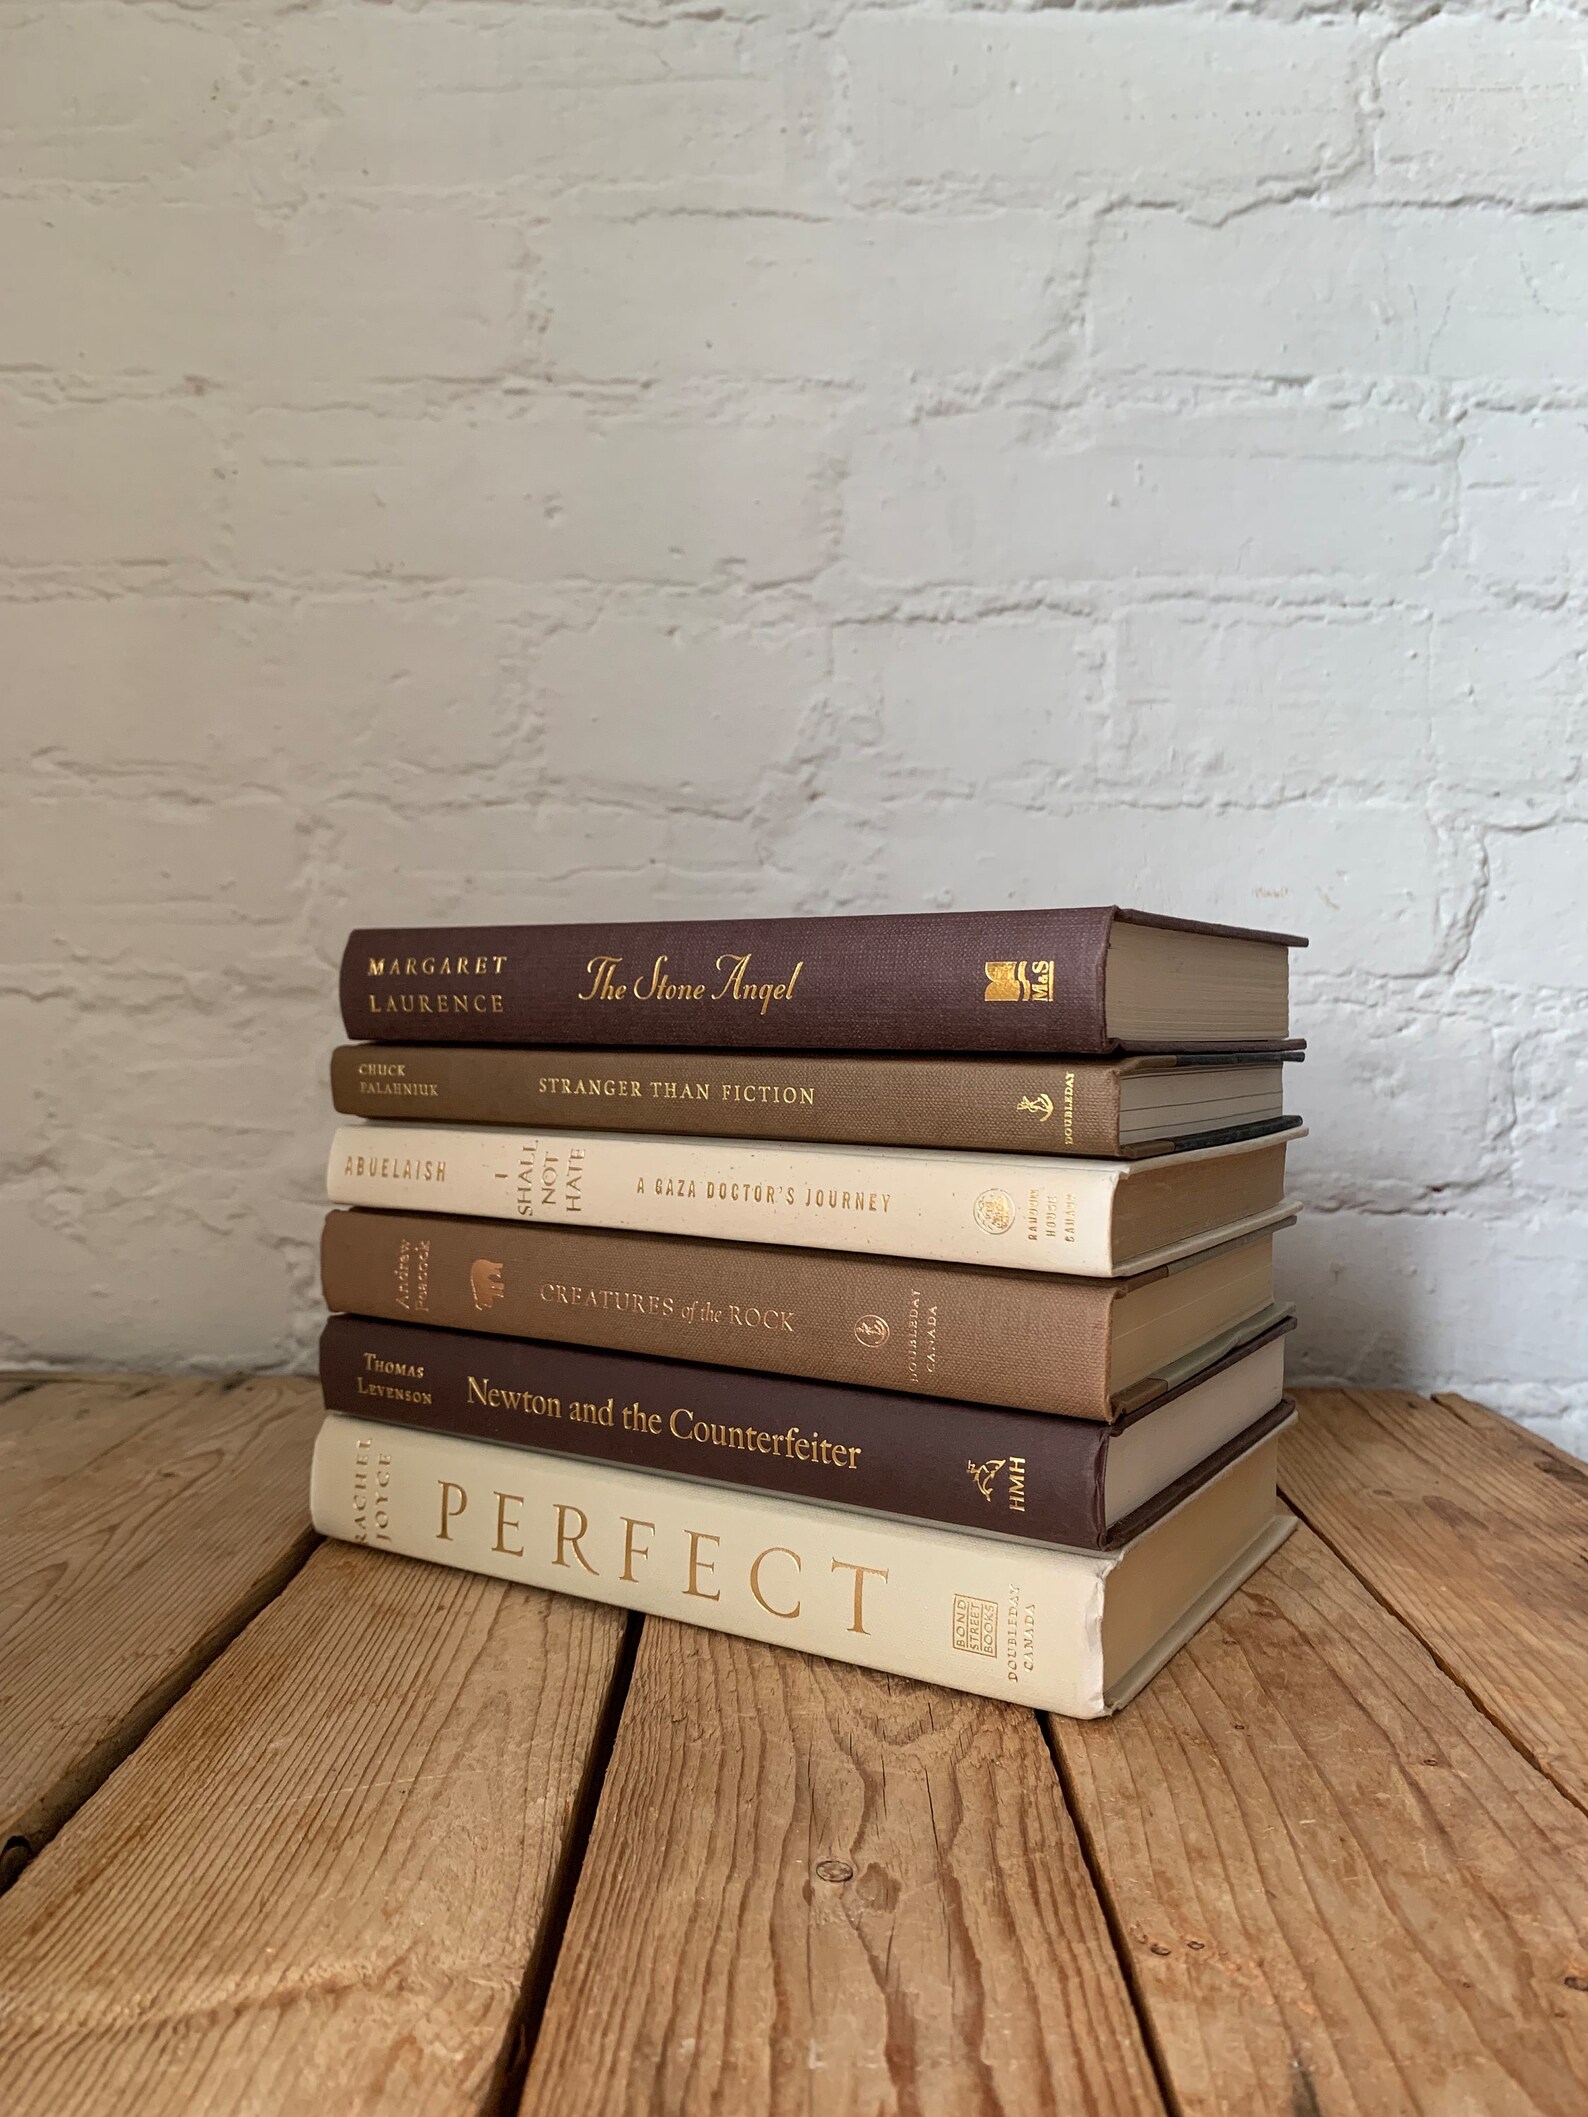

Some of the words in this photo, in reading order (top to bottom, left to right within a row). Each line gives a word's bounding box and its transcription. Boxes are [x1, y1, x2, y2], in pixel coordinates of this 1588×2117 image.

[368, 955, 507, 976] MARGARET
[578, 954, 626, 1000] The
[633, 954, 706, 1000] Stone
[711, 953, 804, 1016] Angel
[1031, 960, 1050, 1002] M&S
[369, 994, 504, 1013] LAURENCE
[358, 1063, 406, 1077] CHUCK
[360, 1081, 439, 1097] PALAHNIUK
[539, 1077, 642, 1098] STRANGER
[650, 1081, 710, 1101] THAN
[722, 1084, 815, 1105] FICTION
[1064, 1071, 1075, 1145] DOUBLEDAY
[344, 1156, 447, 1183] ABUELAISH
[494, 1172, 509, 1180] I
[518, 1140, 539, 1217] SHALL
[541, 1151, 560, 1206] NOT
[566, 1148, 586, 1213] HATE
[636, 1177, 645, 1195] A
[655, 1178, 696, 1199] GAZA
[805, 1188, 890, 1213] JOURNEY
[394, 1239, 412, 1311] Andrew
[539, 1283, 674, 1316] CREATURES
[681, 1300, 698, 1324] of
[700, 1301, 722, 1323] the
[729, 1304, 795, 1332] ROCK
[908, 1288, 920, 1383] DOUBLEDAY
[467, 1375, 562, 1418] Newton
[569, 1397, 614, 1427] and
[622, 1401, 663, 1435] the
[669, 1407, 862, 1470] Counterfeiter
[354, 1437, 373, 1546] RACHEL
[375, 1453, 392, 1543] JOYCE
[1009, 1456, 1026, 1512] HMH
[435, 1479, 890, 1637] PERFECT
[956, 1599, 967, 1648] BOND
[969, 1602, 980, 1651] STREET
[983, 1604, 995, 1655] BOOKS
[1008, 1583, 1020, 1684] DOUBLEDAY
[1023, 1604, 1036, 1672] CANADA
